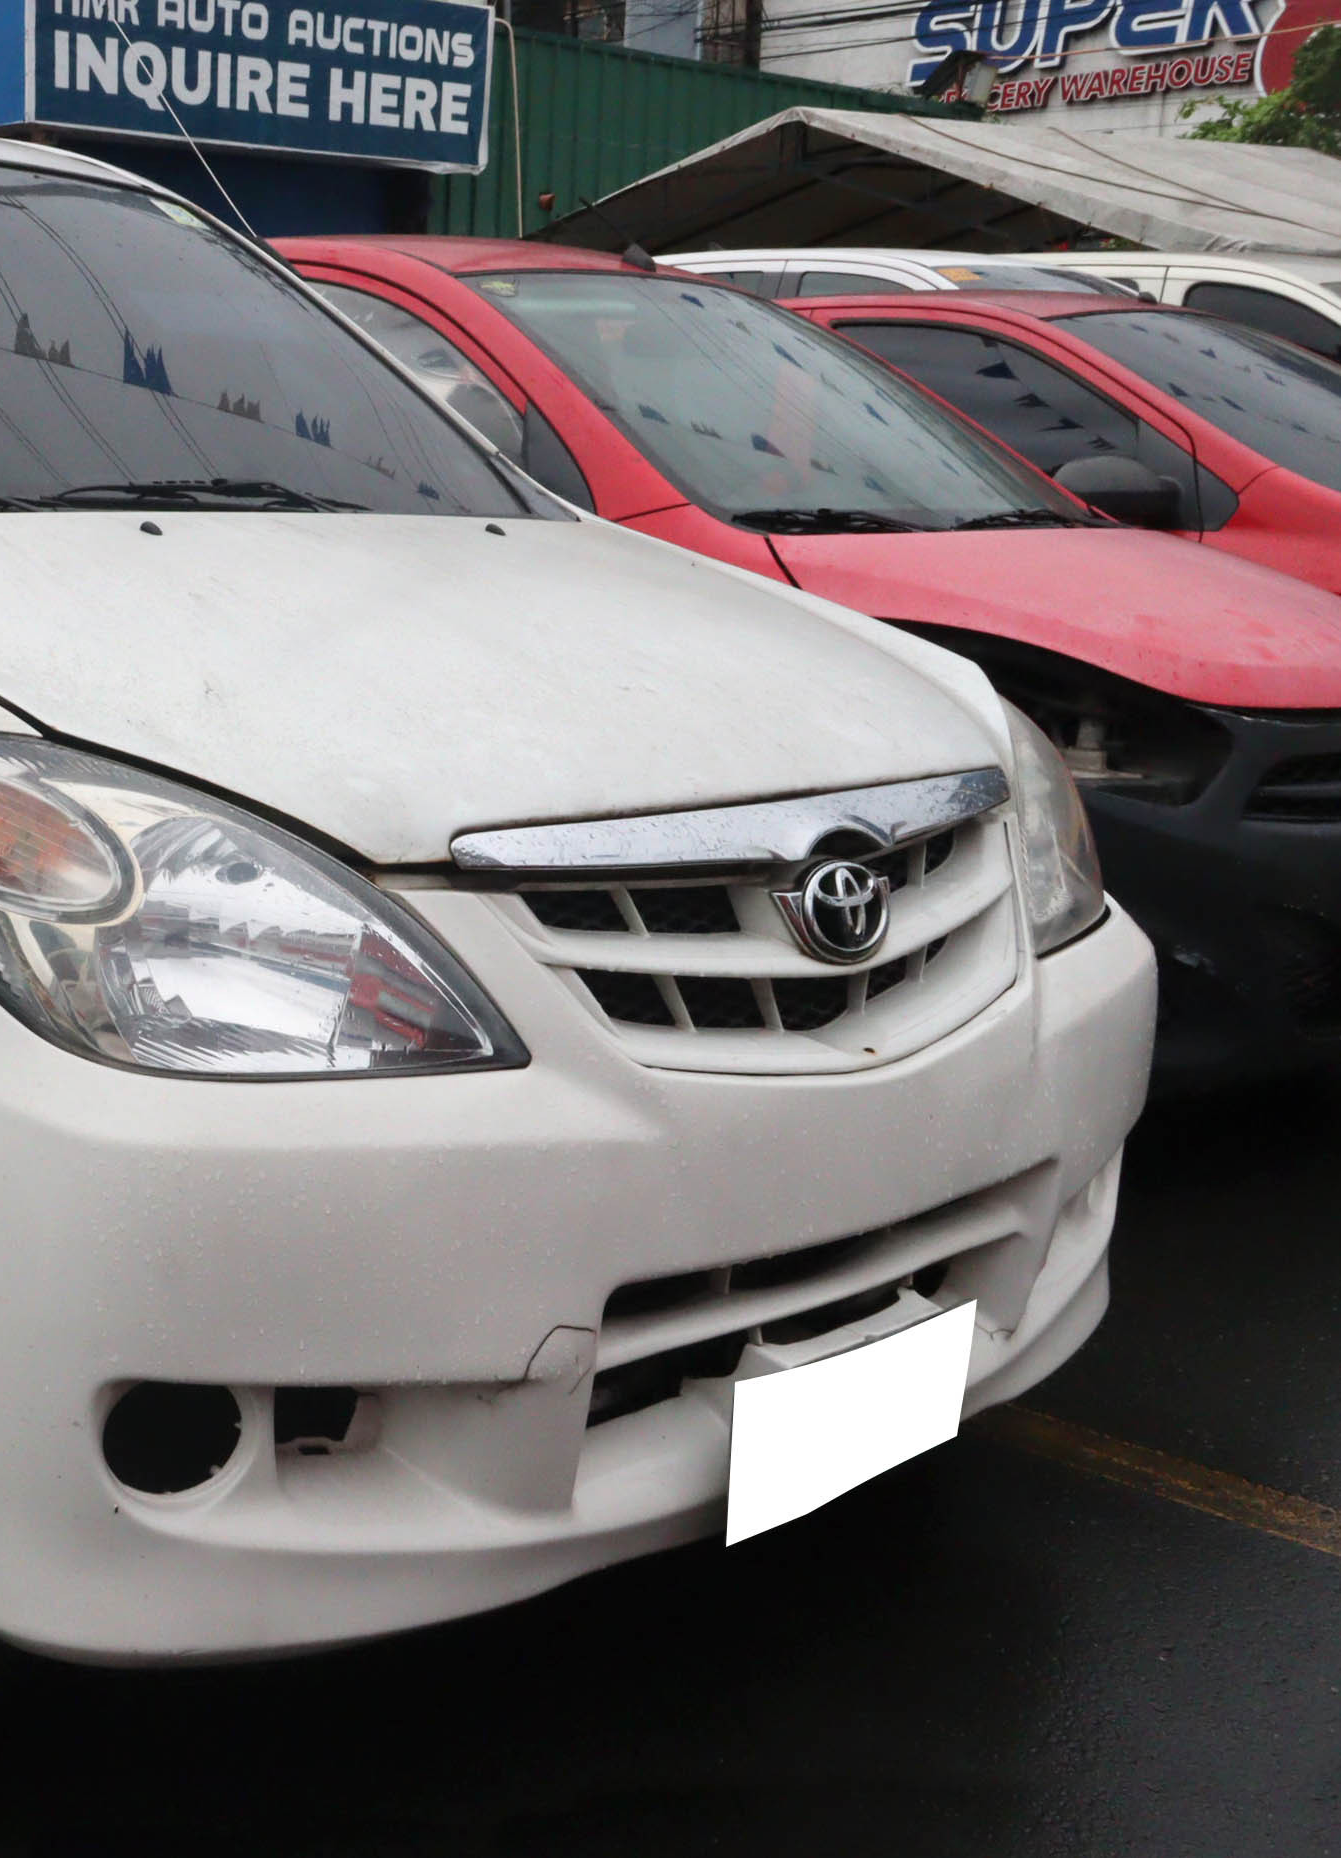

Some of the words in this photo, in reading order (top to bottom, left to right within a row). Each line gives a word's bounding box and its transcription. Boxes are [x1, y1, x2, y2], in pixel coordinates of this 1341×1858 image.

[157, 0, 269, 41] AUTO
[288, 9, 475, 68] AUCTIONS
[54, 29, 312, 119] INQUIRE
[328, 66, 473, 136] HERE
[1060, 52, 1254, 102] WAREHOUSE
